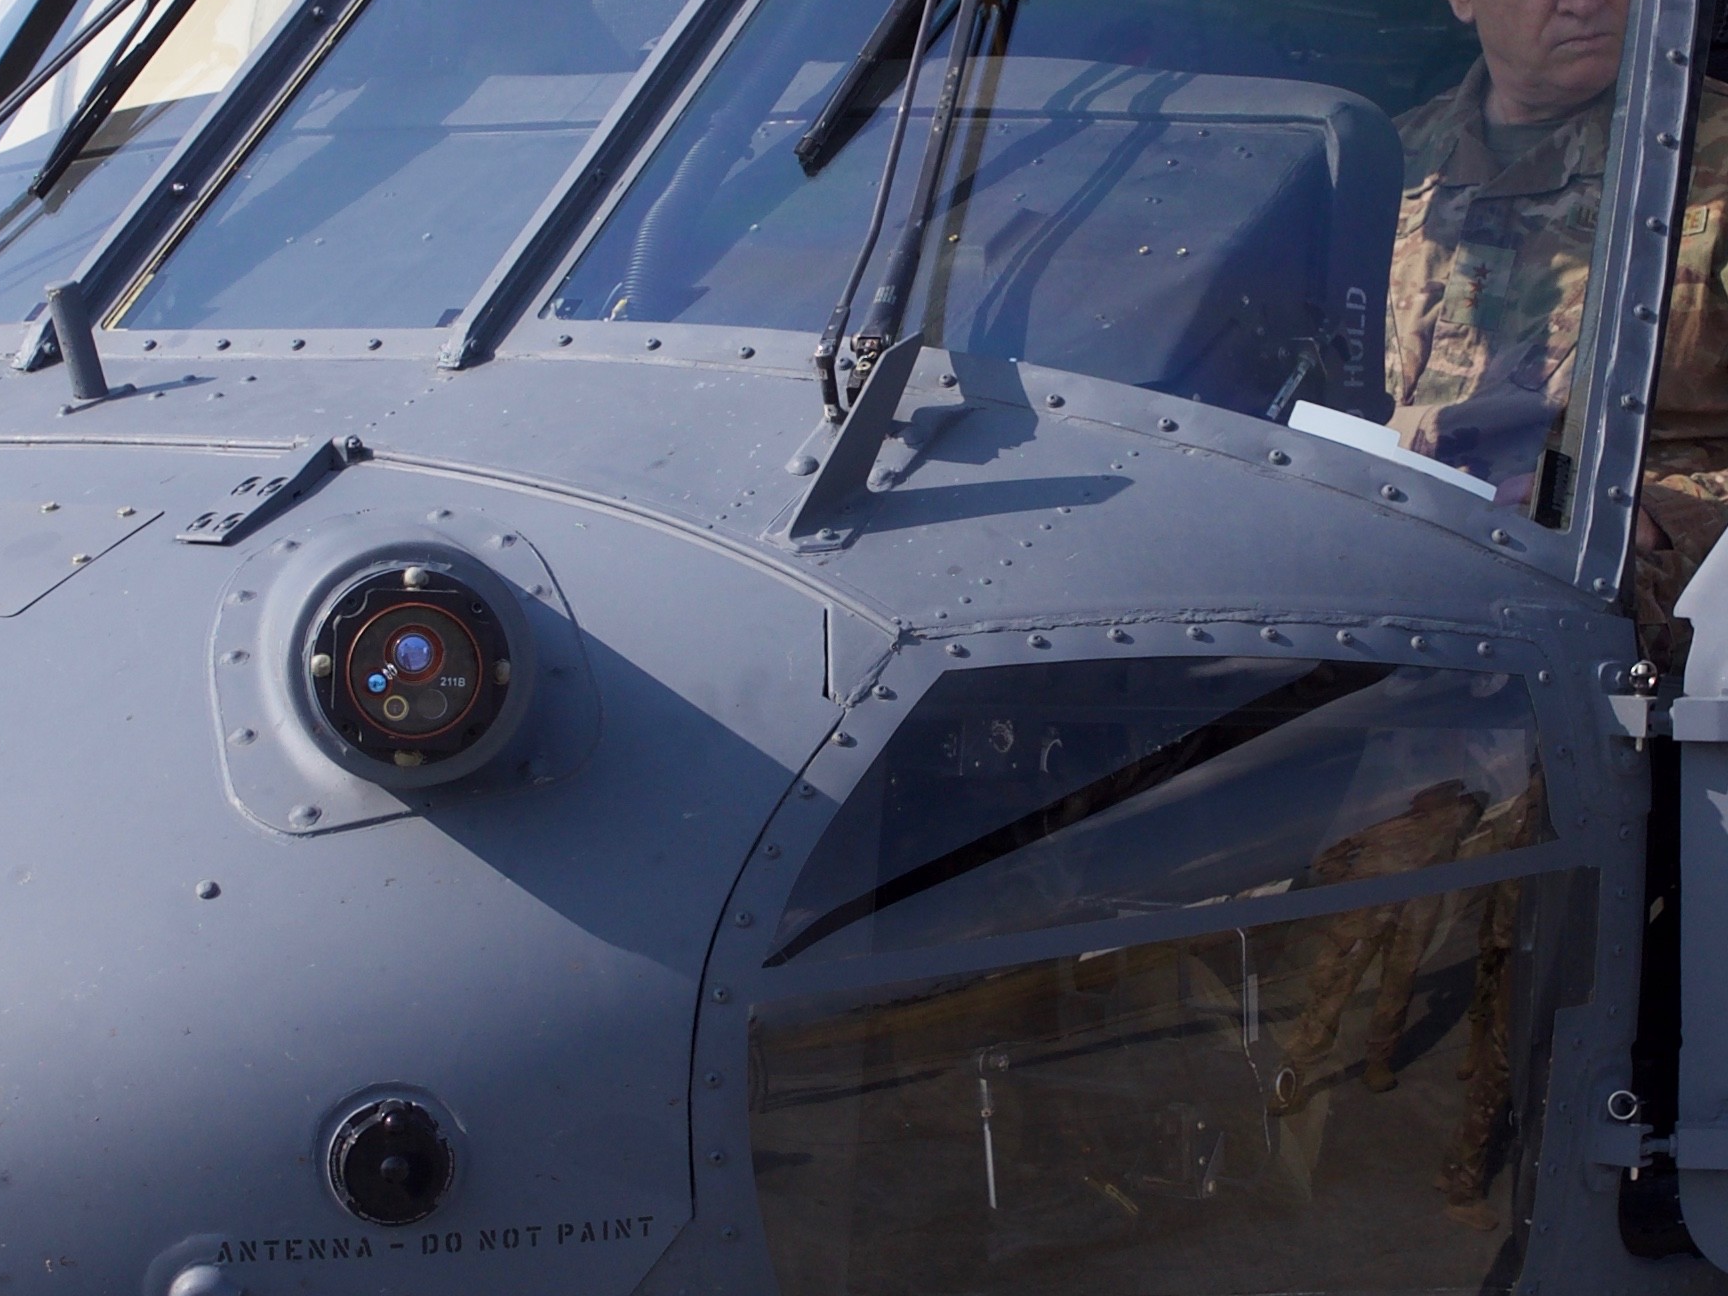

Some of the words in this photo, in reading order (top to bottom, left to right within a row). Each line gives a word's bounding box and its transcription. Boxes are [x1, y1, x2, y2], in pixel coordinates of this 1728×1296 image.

[217, 1236, 374, 1264] ANTENNA
[420, 1233, 464, 1256] DO
[478, 1225, 544, 1250] NOT
[557, 1215, 656, 1245] PAINT
